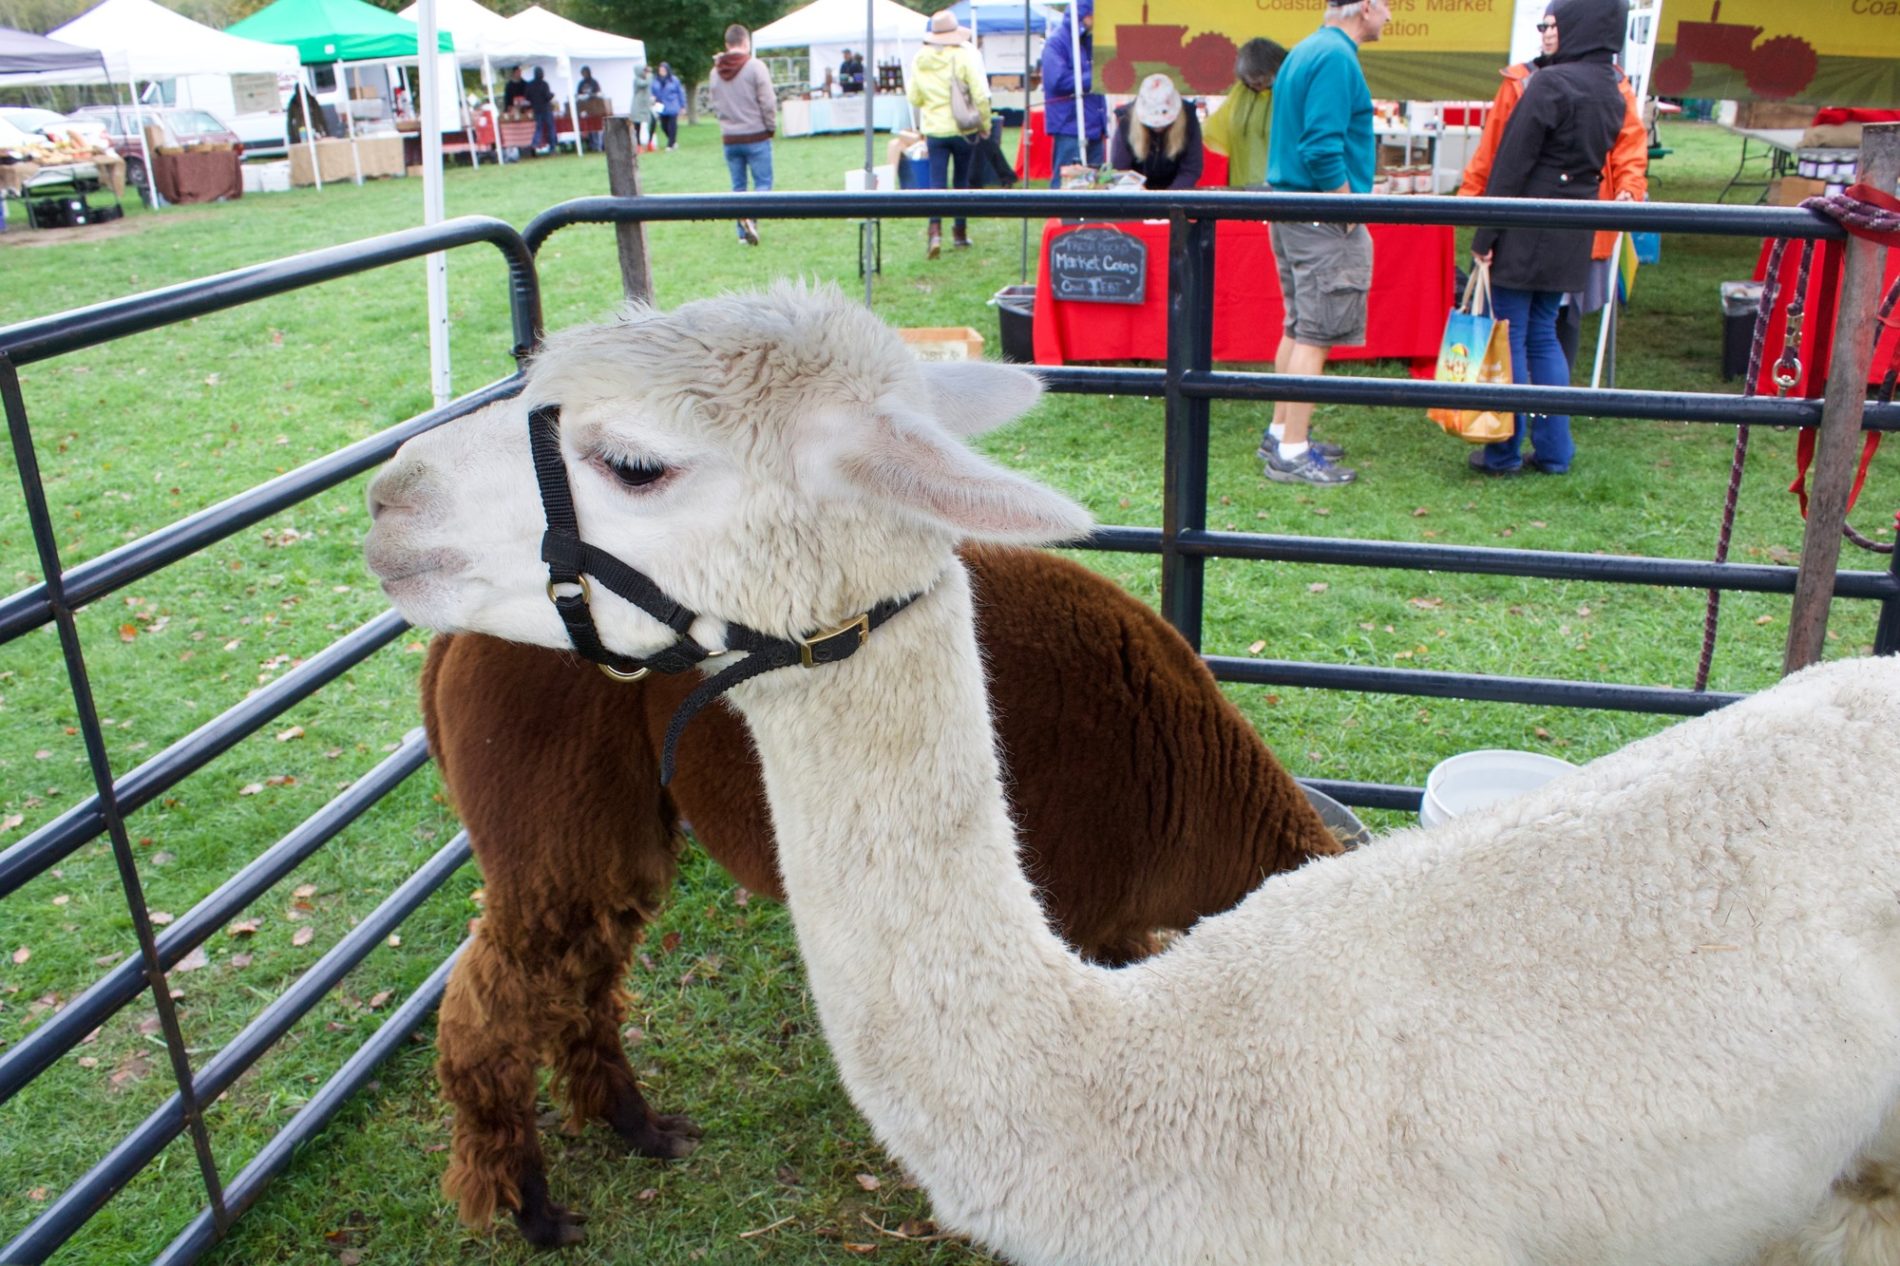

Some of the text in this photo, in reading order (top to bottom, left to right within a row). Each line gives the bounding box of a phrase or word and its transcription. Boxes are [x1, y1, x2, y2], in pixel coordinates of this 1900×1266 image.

[1426, 0, 1493, 12] Market
[1852, 0, 1900, 16] Coa
[1382, 20, 1429, 37] ation
[1056, 252, 1138, 274] Market Coins
